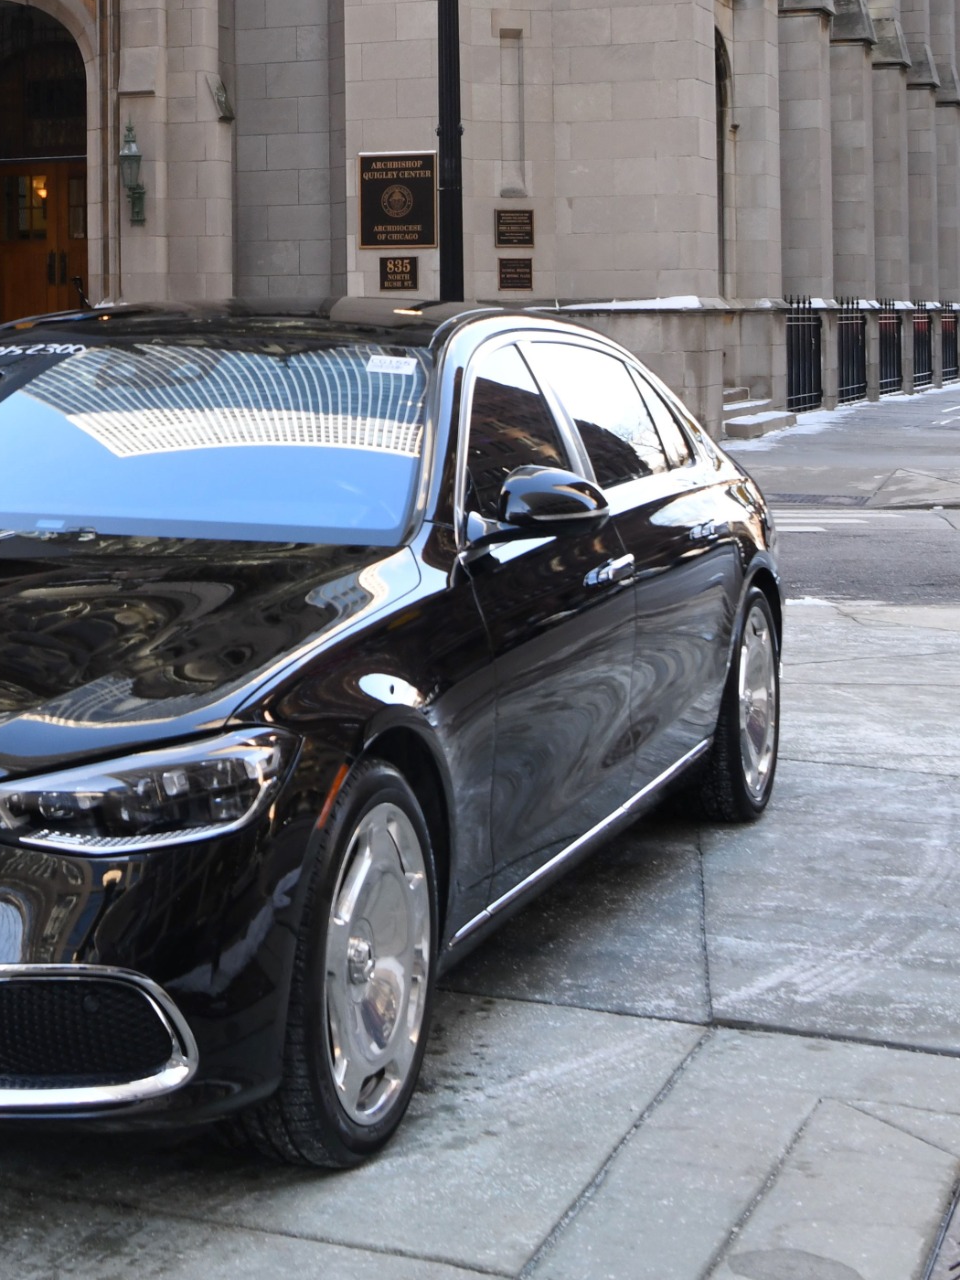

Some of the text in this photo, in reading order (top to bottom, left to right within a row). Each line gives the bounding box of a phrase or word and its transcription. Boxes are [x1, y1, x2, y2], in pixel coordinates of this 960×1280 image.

[370, 160, 423, 169] ARCHBISHOP
[362, 170, 432, 180] QUIGLEY CENTER
[373, 224, 422, 232] ARCHDIOCESE
[376, 233, 419, 241] OF CHICAGO
[386, 259, 411, 273] 835
[387, 273, 410, 281] NORTH
